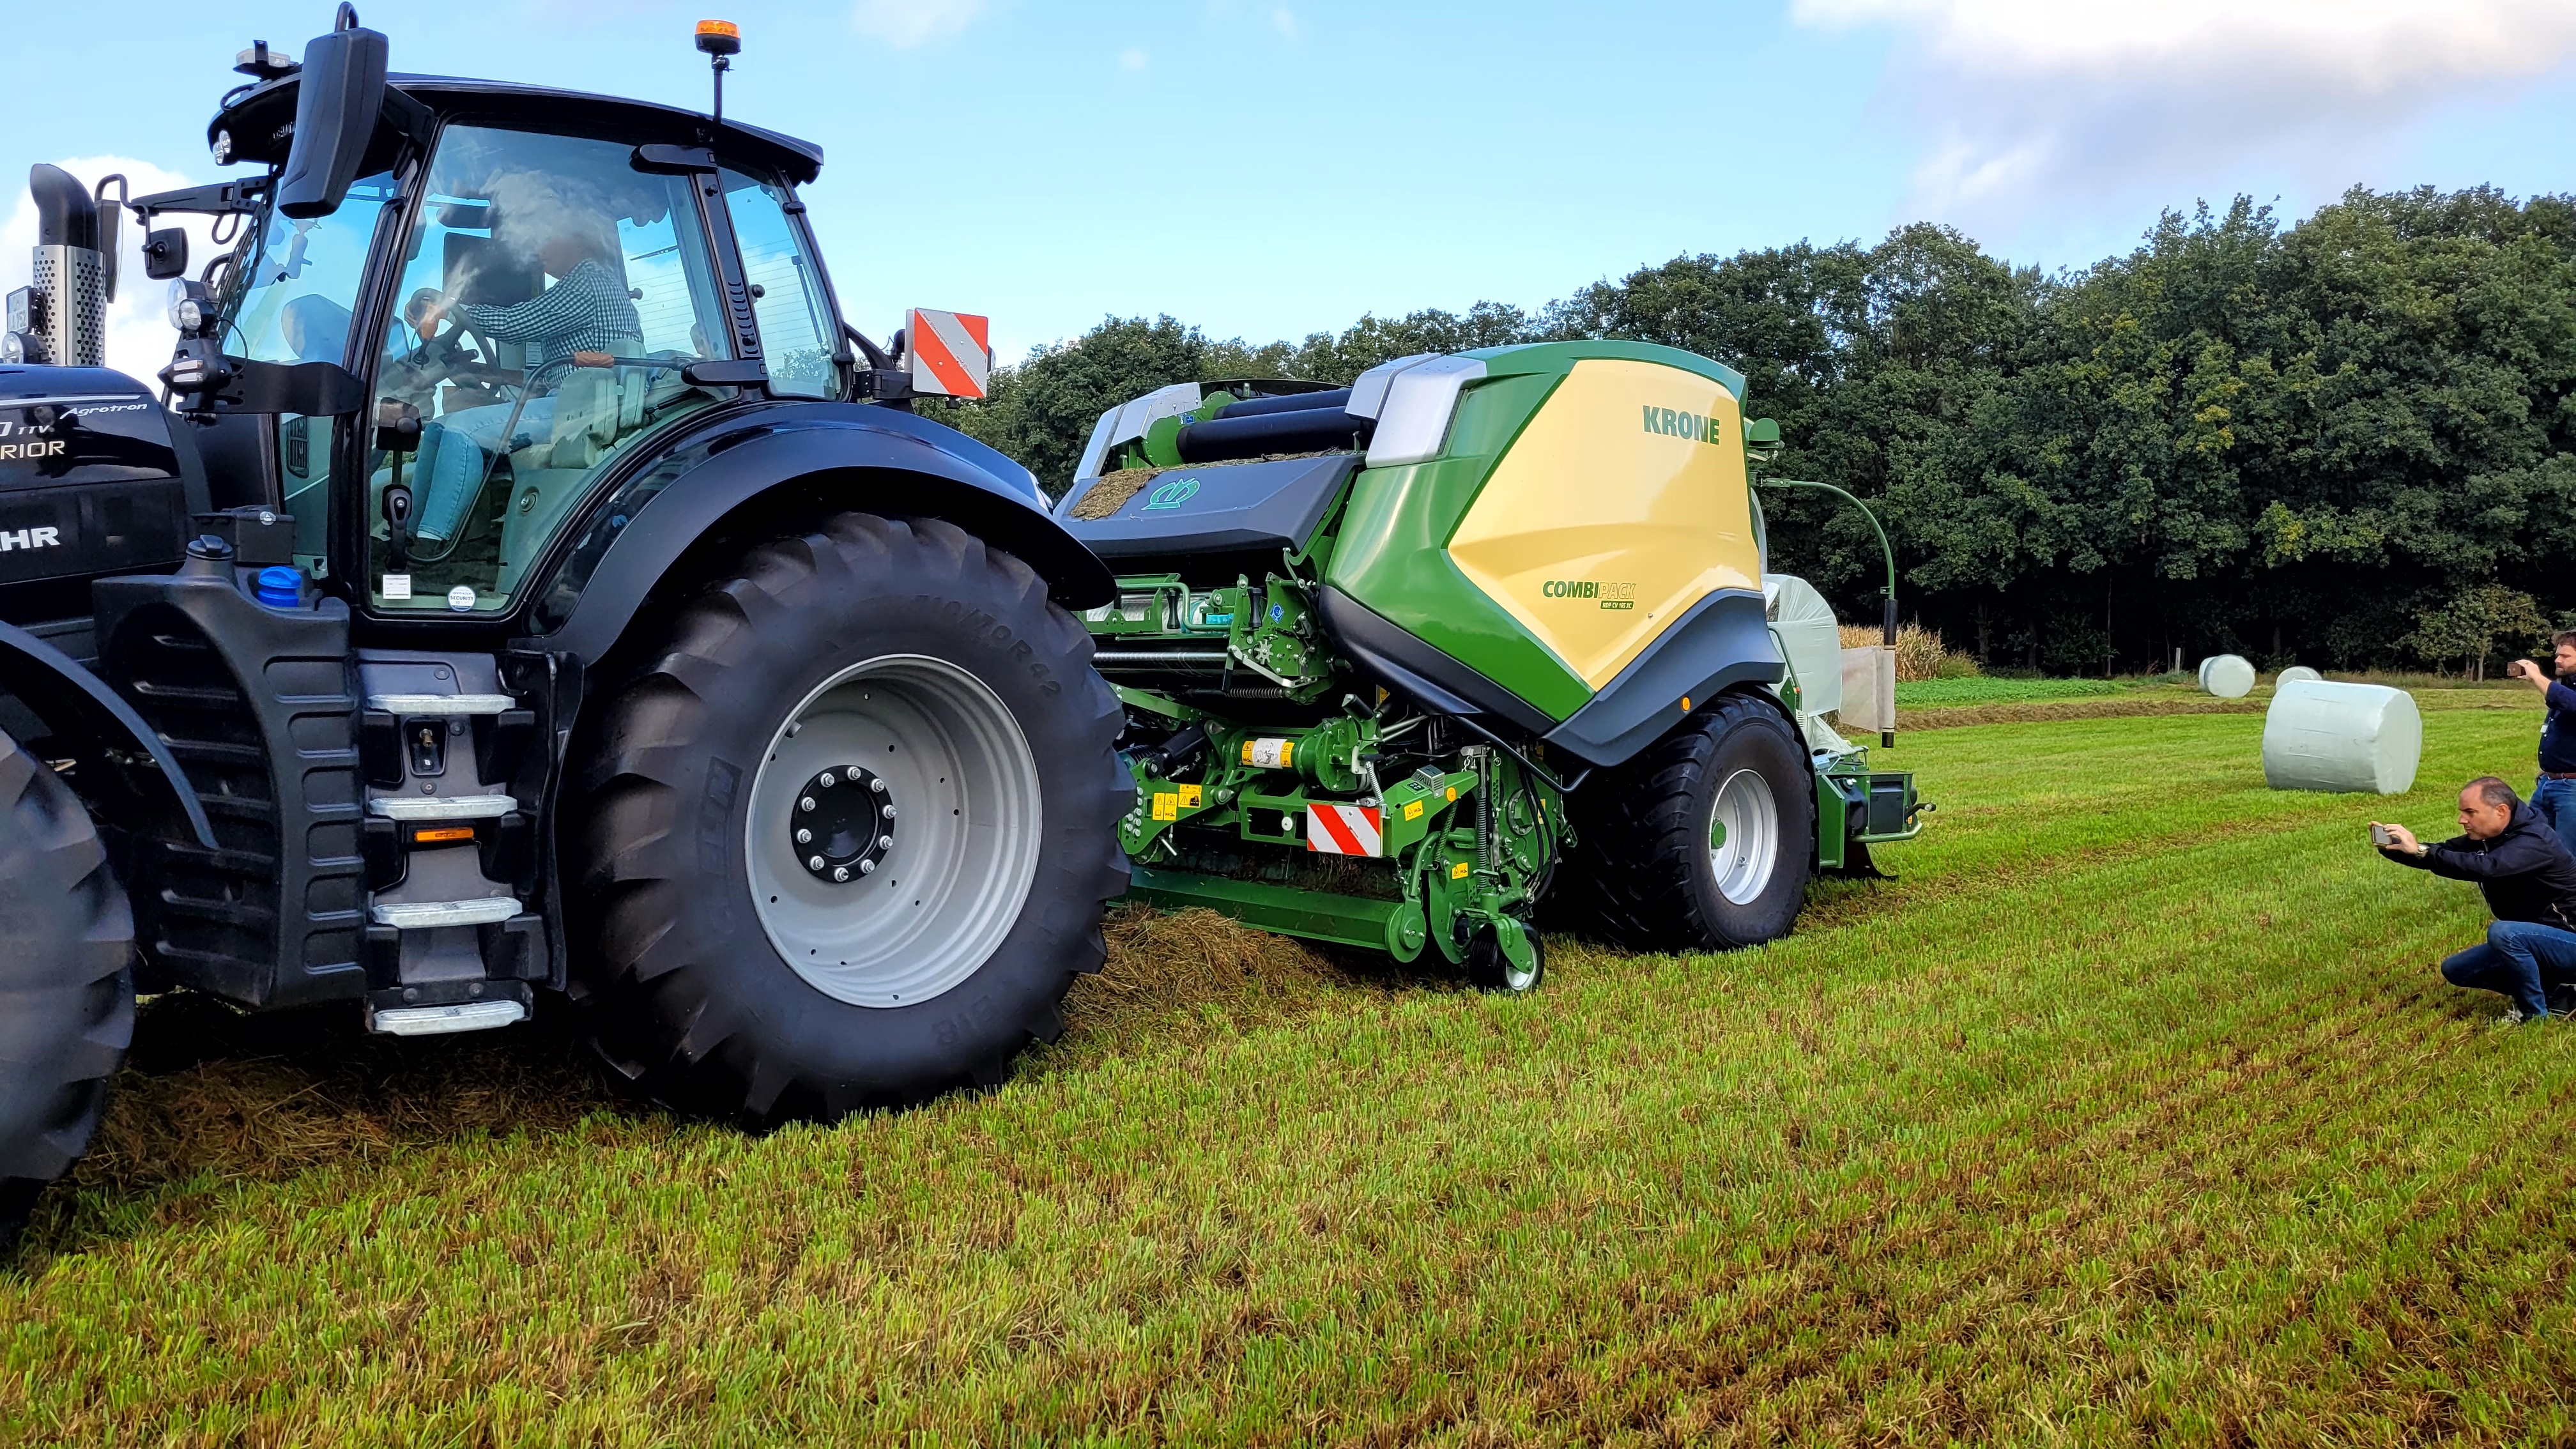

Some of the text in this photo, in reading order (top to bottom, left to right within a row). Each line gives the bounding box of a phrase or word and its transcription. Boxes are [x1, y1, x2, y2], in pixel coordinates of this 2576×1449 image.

[59, 403, 148, 419] Agrotron
[18, 425, 50, 435] TTV
[1643, 404, 1720, 445] KRONE
[0, 440, 65, 460] RIOR
[0, 526, 61, 552] HR
[1542, 580, 1636, 599] COMBIPACK
